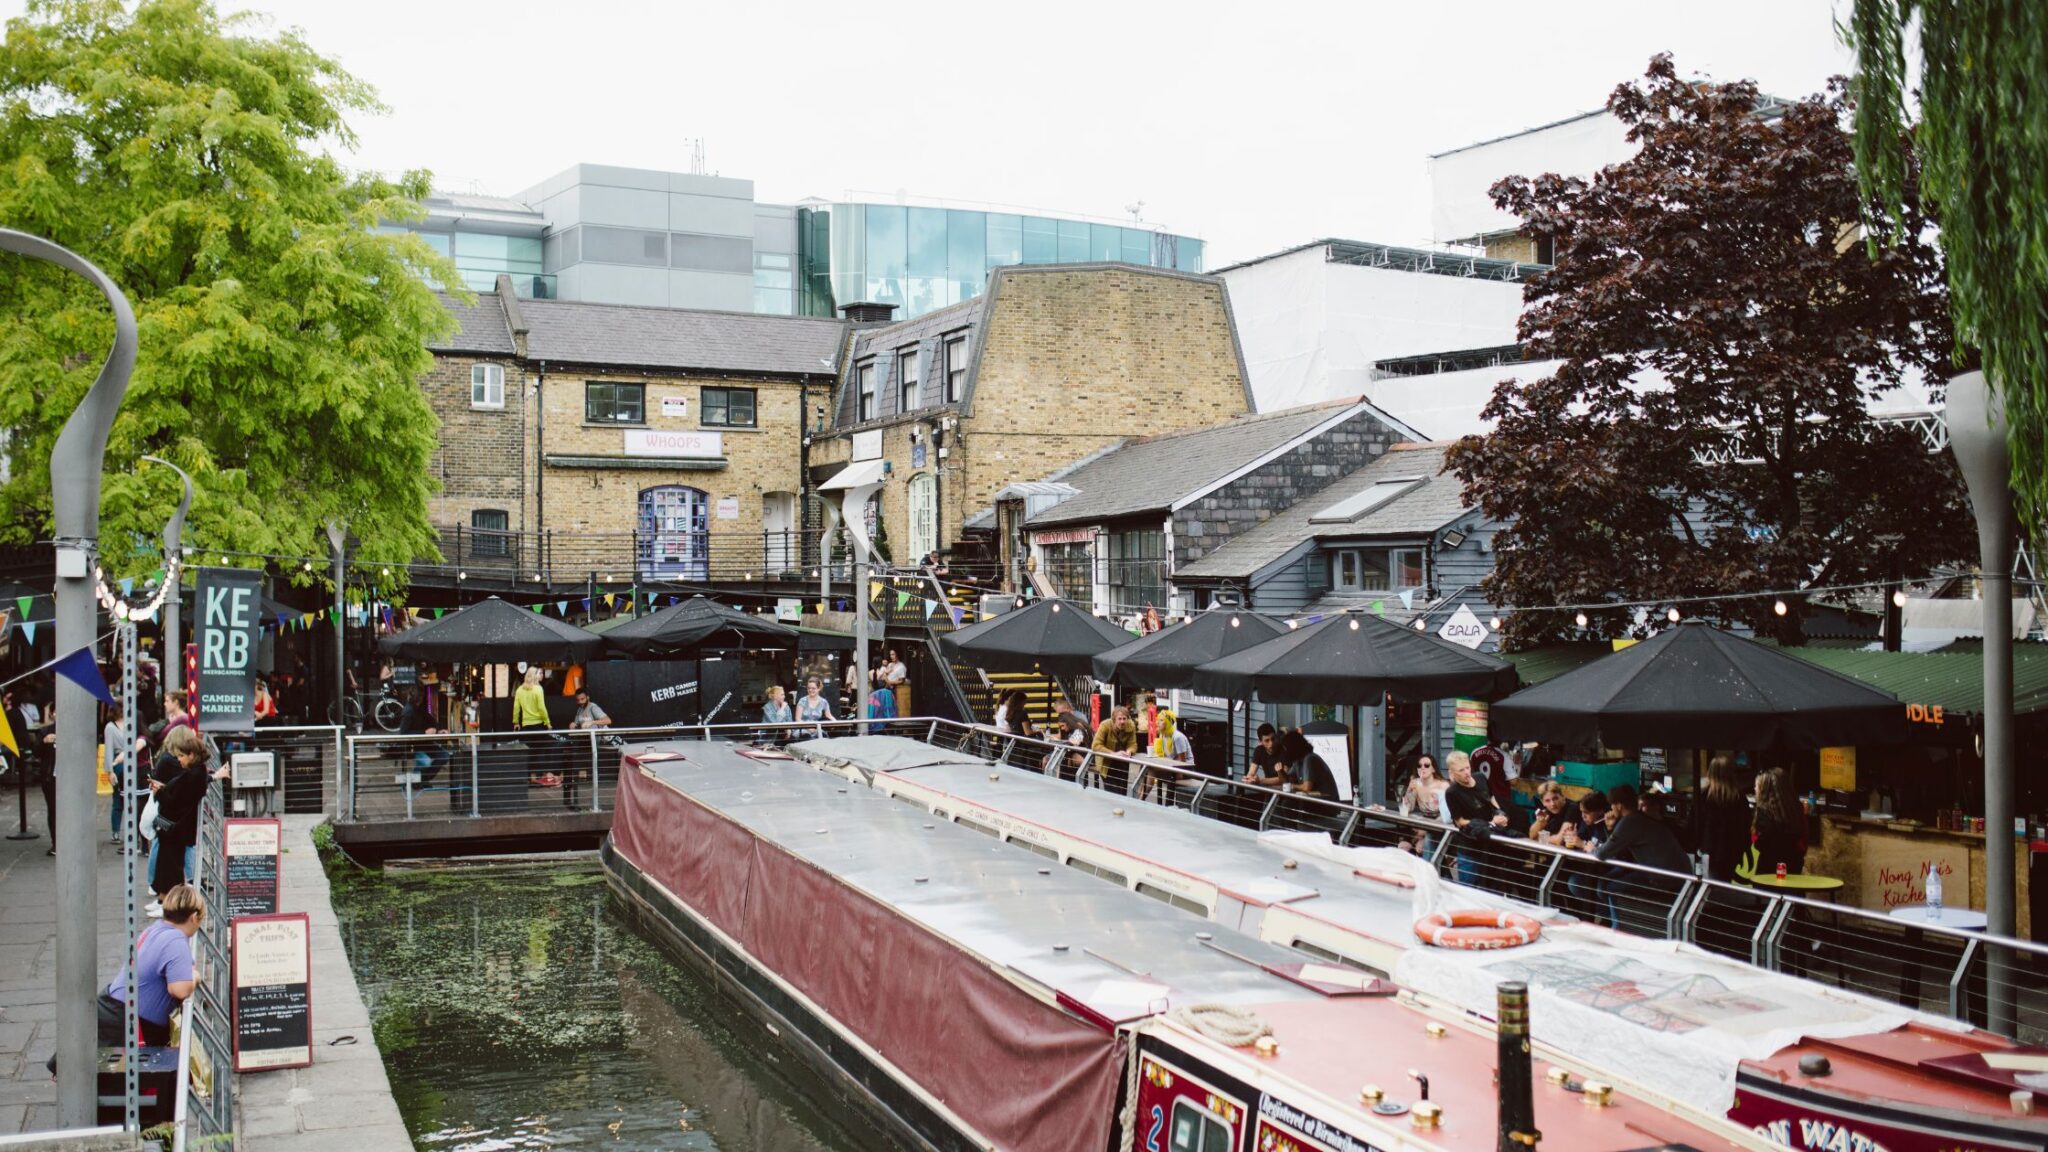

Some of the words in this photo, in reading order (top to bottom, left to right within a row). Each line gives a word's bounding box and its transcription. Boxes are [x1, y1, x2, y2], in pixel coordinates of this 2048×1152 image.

[646, 434, 701, 449] WHOOPS
[205, 586, 251, 628] KE
[1447, 624, 1480, 636] ZALA
[203, 628, 250, 669] RB
[201, 694, 244, 703] CAMDEN
[650, 686, 676, 703] KERB
[201, 704, 243, 713] MARKET
[1906, 703, 1944, 724] DLE
[1878, 867, 1914, 888] Nong
[1883, 886, 1927, 907] Kitche
[1147, 1104, 1164, 1151] 2
